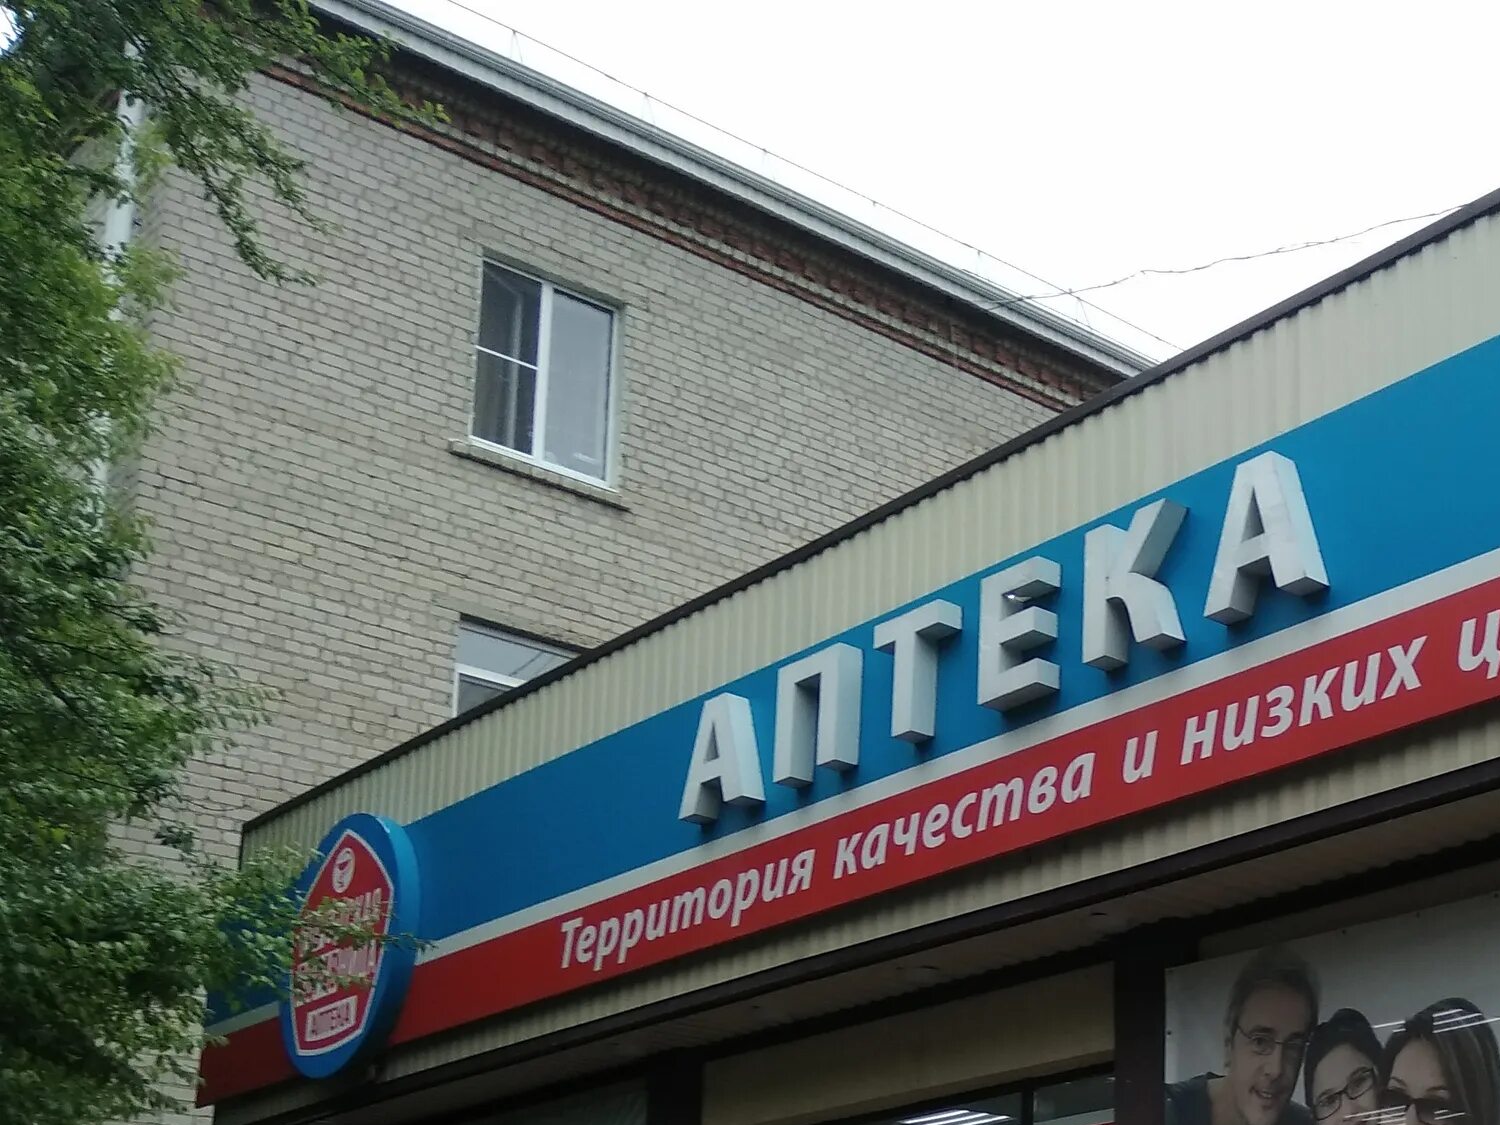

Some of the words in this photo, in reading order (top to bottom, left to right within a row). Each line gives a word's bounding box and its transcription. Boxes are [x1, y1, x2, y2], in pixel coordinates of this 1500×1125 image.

[560, 849, 816, 971] Территория
[832, 751, 1097, 881] качества
[1122, 728, 1159, 785] и
[1180, 634, 1428, 766] низких
[678, 450, 1331, 825] АПТЕКА
